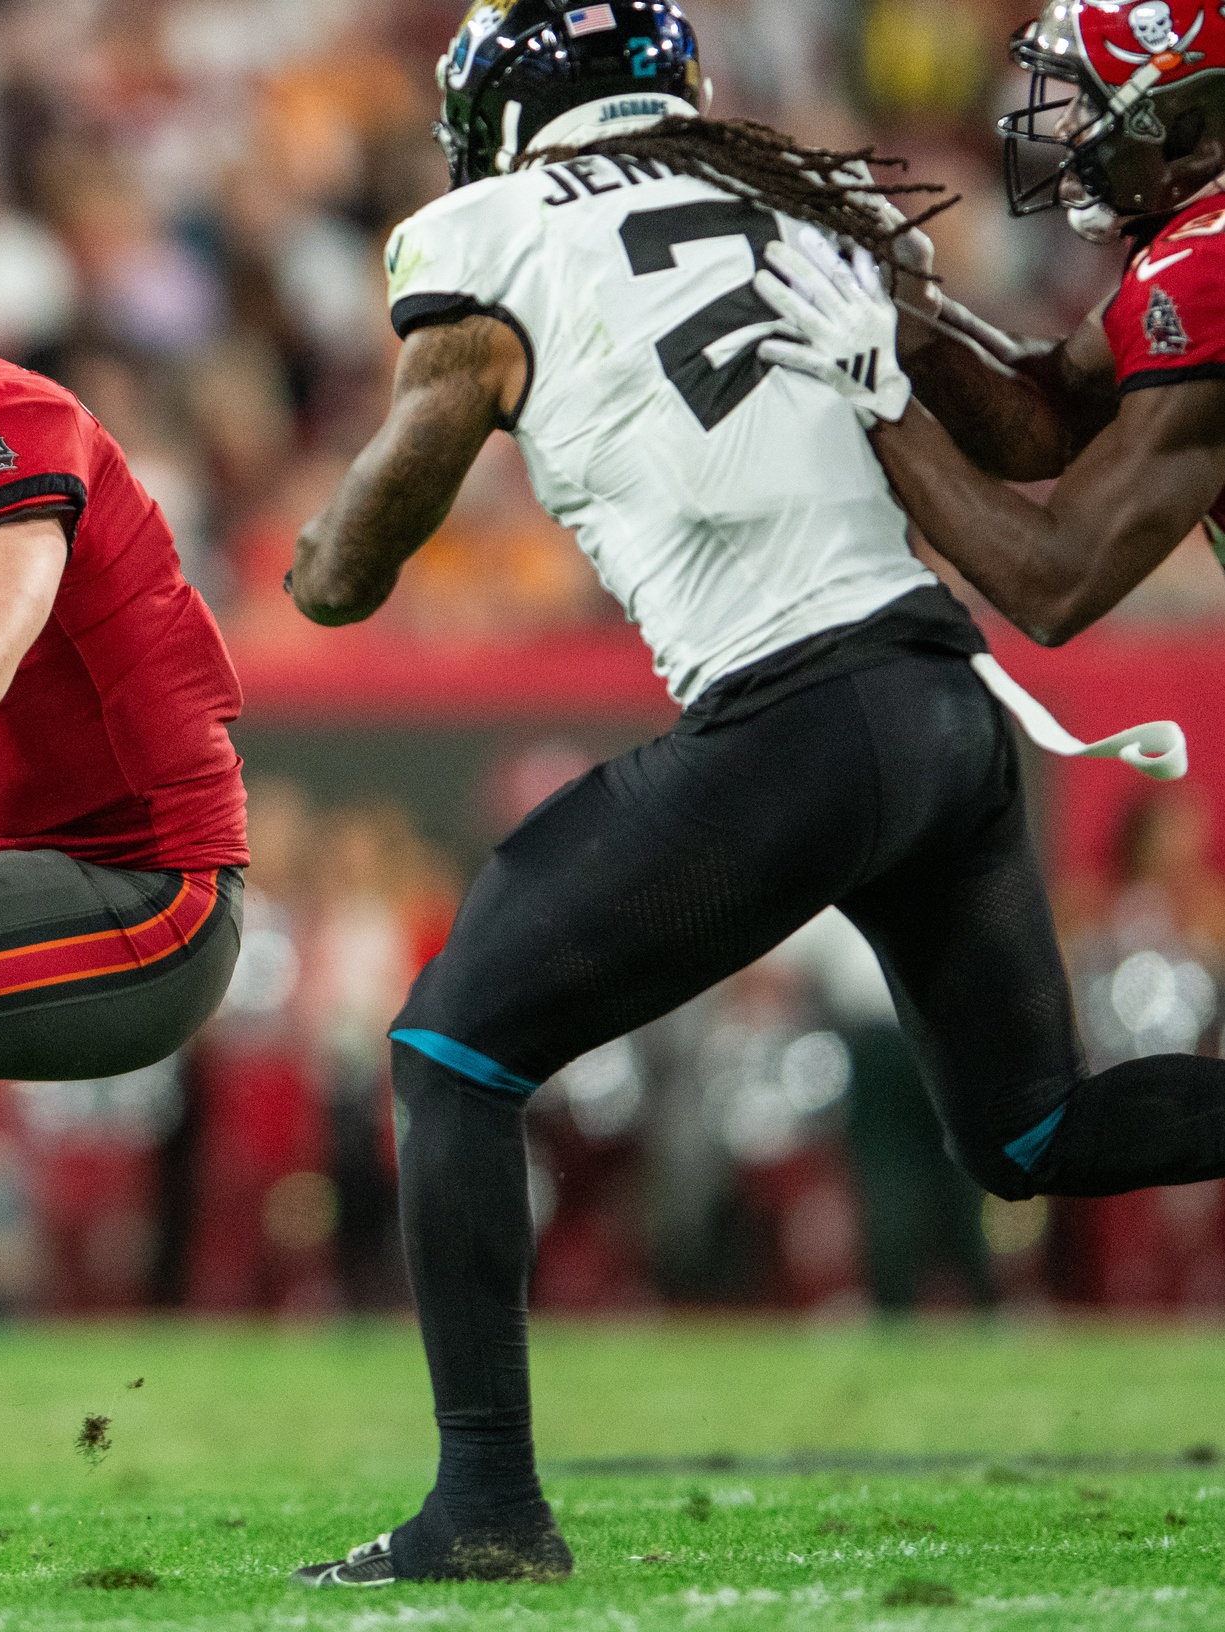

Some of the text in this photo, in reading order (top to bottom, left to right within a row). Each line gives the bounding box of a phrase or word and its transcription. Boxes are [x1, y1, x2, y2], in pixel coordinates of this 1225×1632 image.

[628, 36, 657, 78] 2
[599, 99, 668, 122] JAGUARS
[543, 152, 664, 206] JEN
[618, 198, 786, 433] 2
